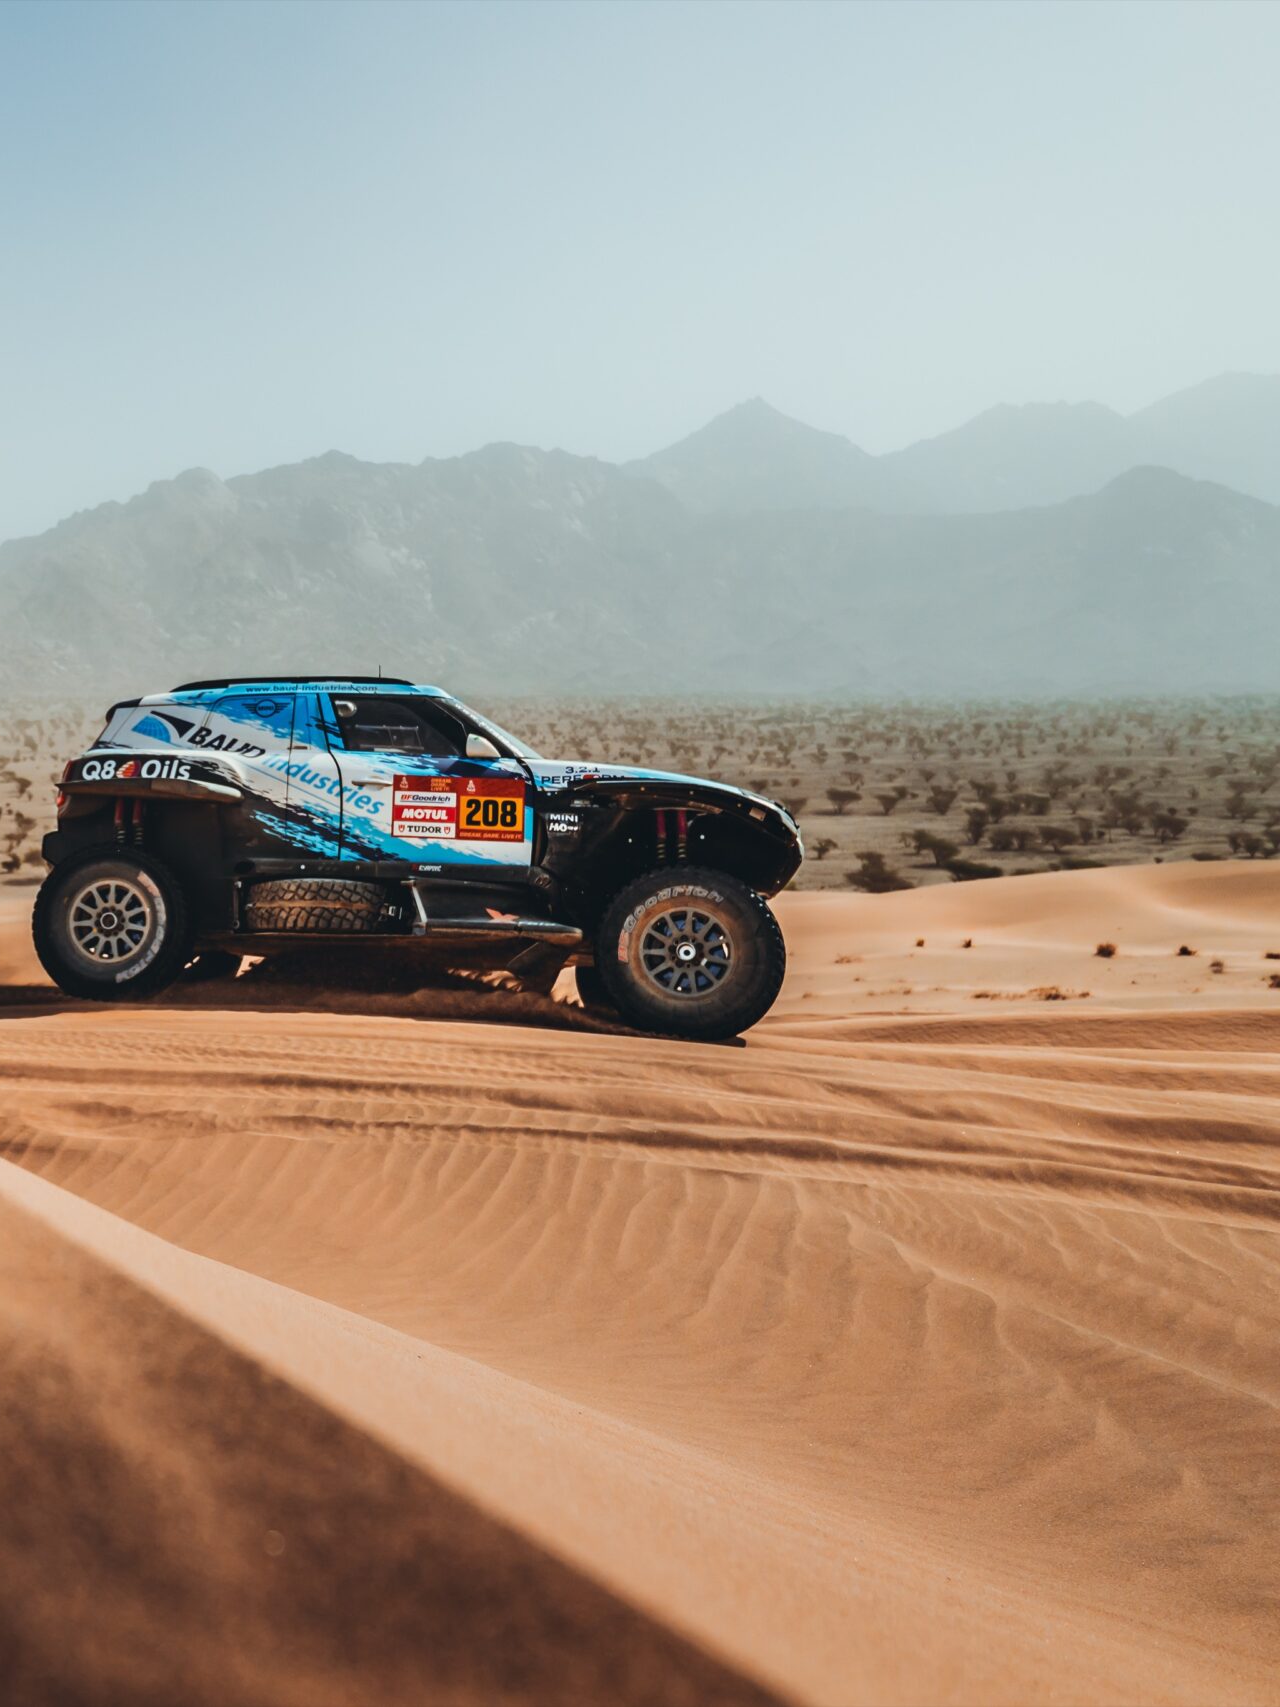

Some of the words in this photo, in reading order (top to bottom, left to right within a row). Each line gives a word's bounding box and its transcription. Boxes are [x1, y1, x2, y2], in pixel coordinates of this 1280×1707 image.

[187, 726, 266, 759] BAUD
[82, 760, 116, 780] Q8
[141, 759, 191, 780] Oils
[565, 766, 600, 774] 3.2.1
[401, 794, 451, 802] BFGoodrich
[401, 808, 448, 820] MOTUL
[465, 798, 517, 828] 208
[550, 813, 579, 822] MINI
[407, 825, 442, 834] TUDOR
